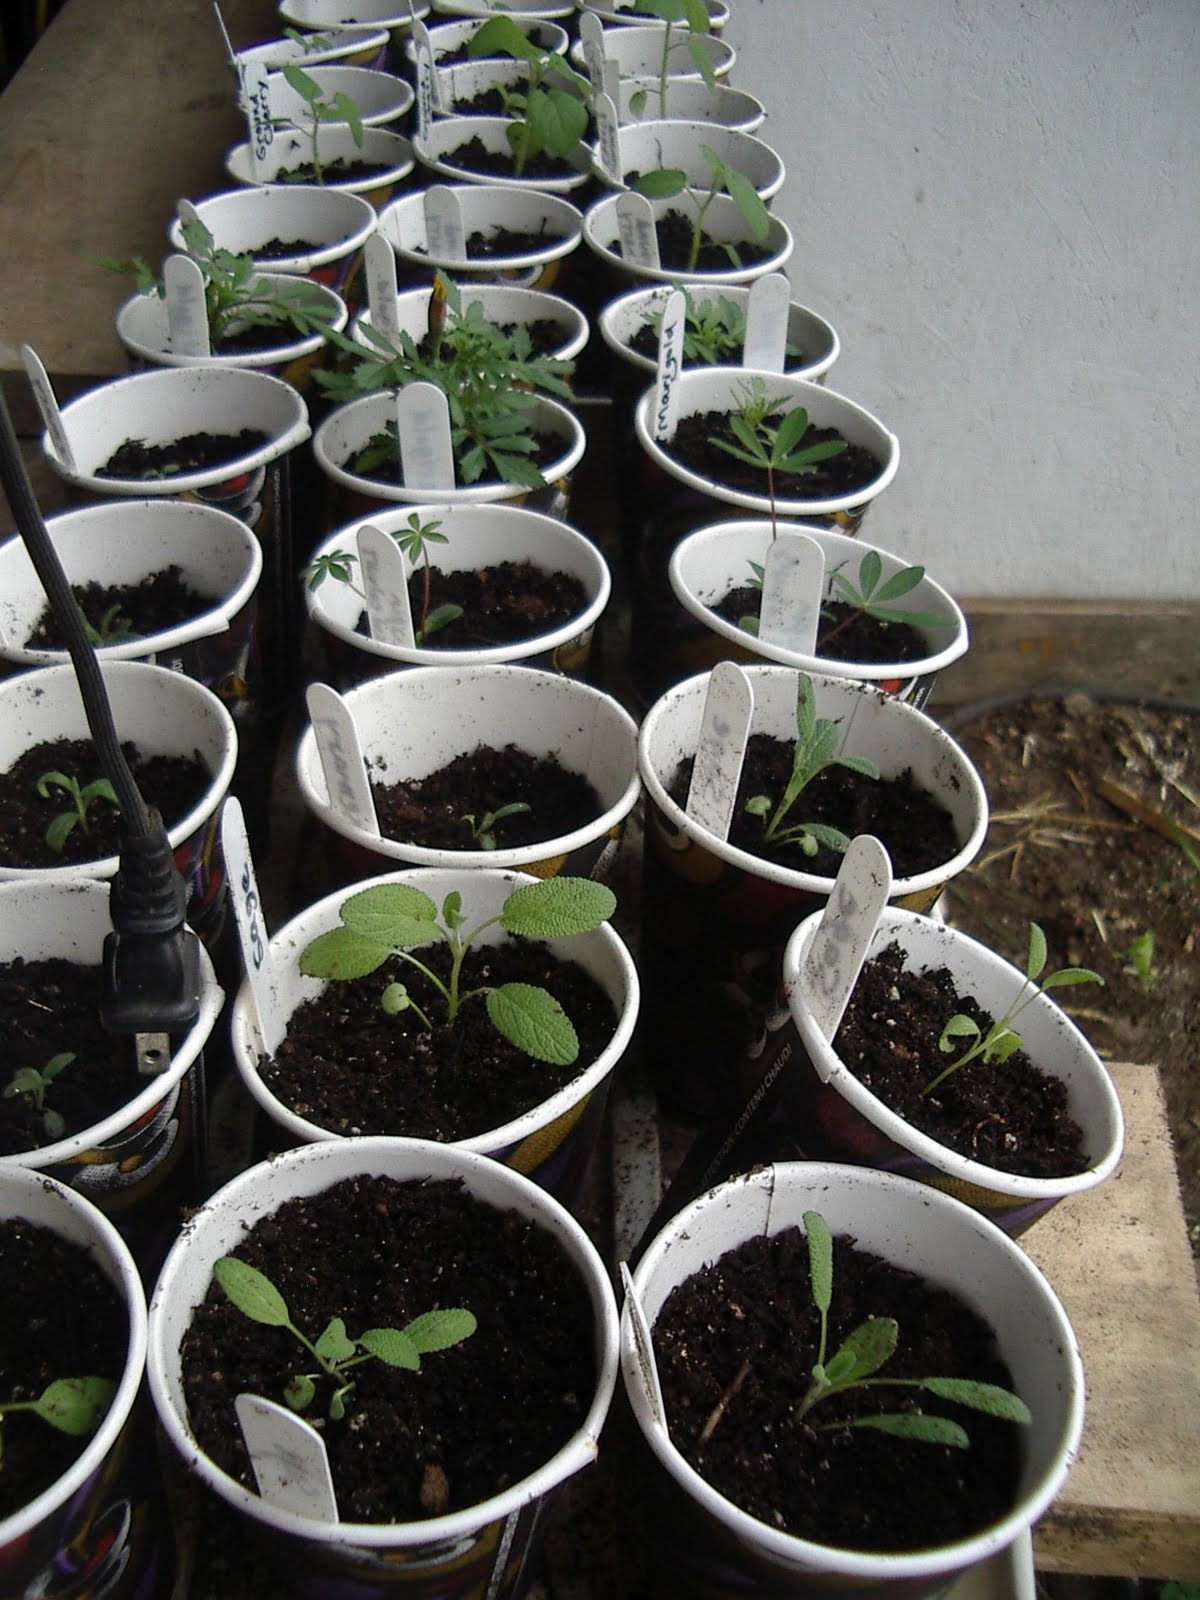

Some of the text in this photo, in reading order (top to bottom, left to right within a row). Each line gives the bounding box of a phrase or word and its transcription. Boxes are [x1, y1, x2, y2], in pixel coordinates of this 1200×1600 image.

[657, 320, 678, 430] Marigold
[241, 861, 264, 971] Sage
[763, 1042, 793, 1088] CHAUD!
